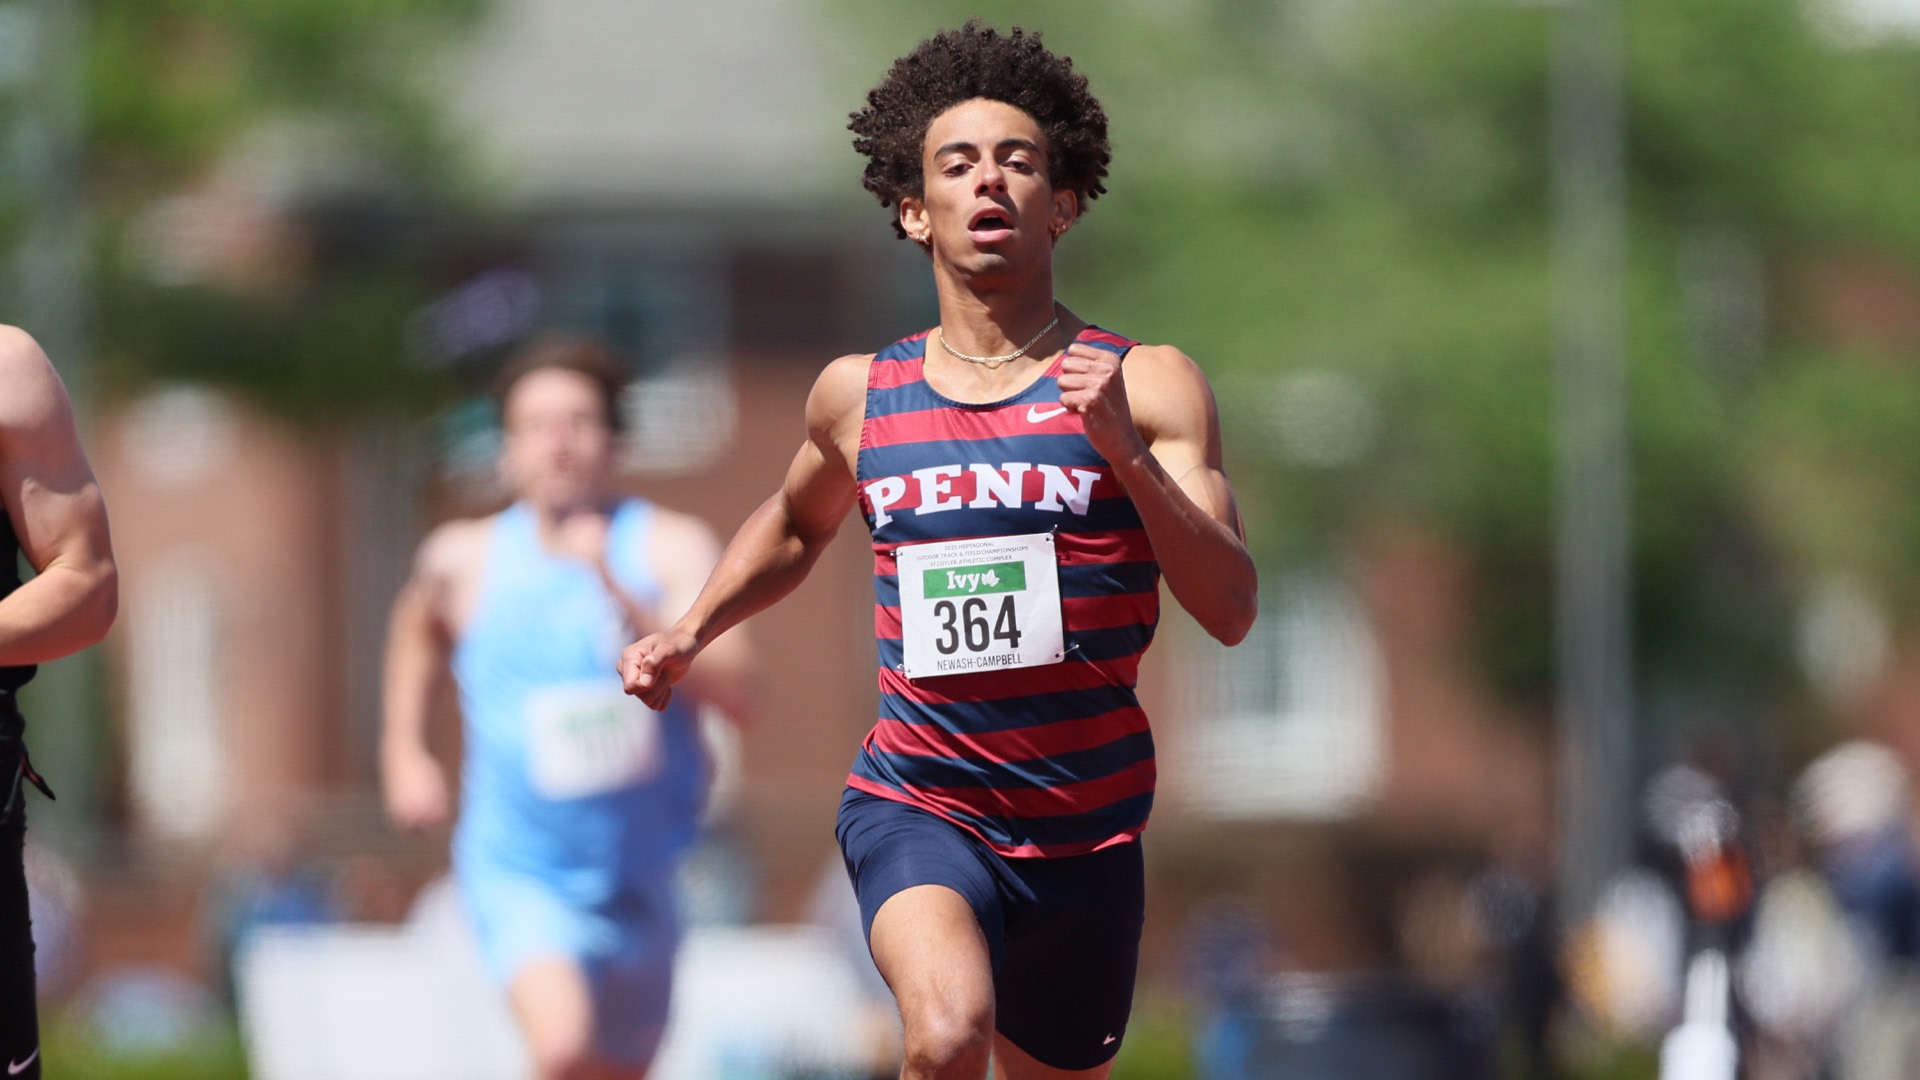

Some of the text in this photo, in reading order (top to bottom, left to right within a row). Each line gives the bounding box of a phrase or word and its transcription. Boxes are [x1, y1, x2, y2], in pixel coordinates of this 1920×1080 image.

[864, 462, 1102, 529] PENN
[916, 553, 940, 561] OUTDOOR
[981, 545, 1029, 555] CHAMPIONSHIPS
[958, 542, 995, 550] HEPTAGONAL
[958, 557, 986, 565] ATHLETIC
[986, 554, 1013, 562] COMPLEX
[946, 570, 981, 593] Ivy
[933, 594, 1022, 655] 364
[937, 652, 1023, 671] NEWASH-CAMPBELL
